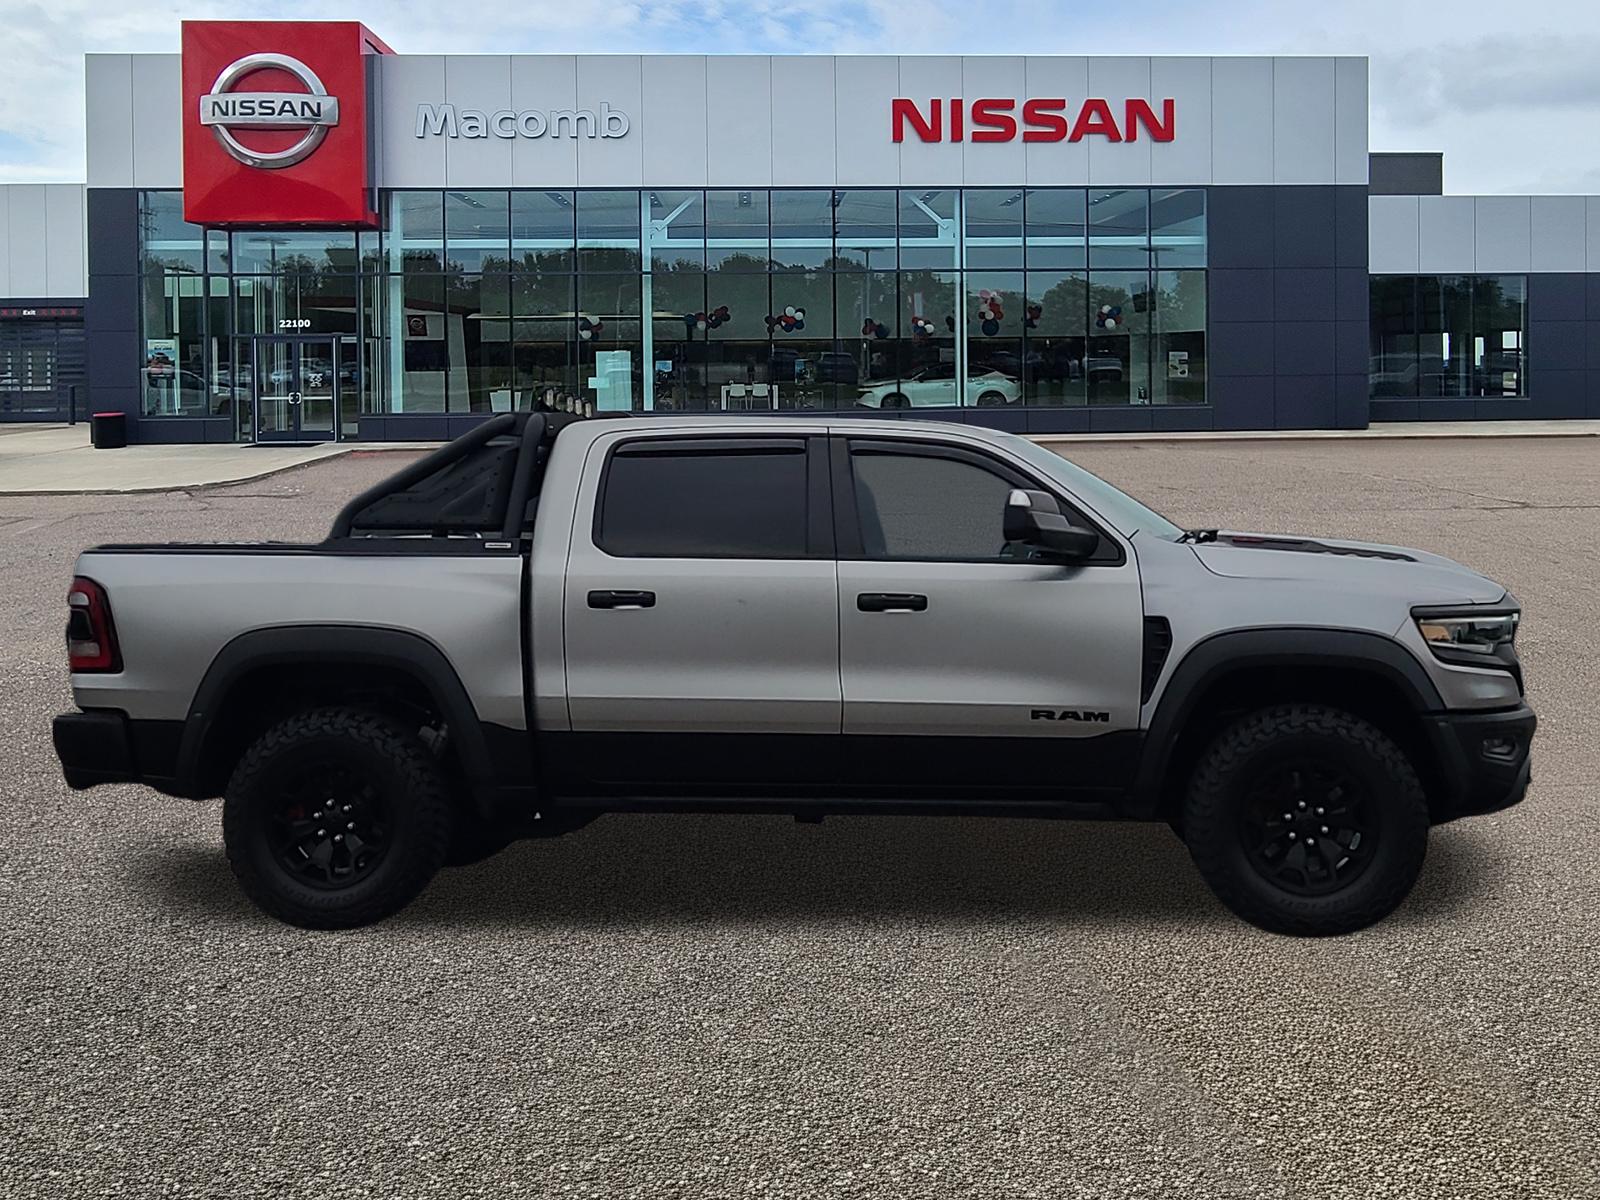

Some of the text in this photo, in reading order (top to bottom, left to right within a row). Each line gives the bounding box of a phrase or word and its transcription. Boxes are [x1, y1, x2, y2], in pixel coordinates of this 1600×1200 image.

[212, 100, 321, 117] NISSAN
[415, 101, 630, 139] Macomb
[892, 98, 1175, 143] NISSAN
[279, 319, 311, 328] 22100
[1030, 709, 1110, 722] RAM
